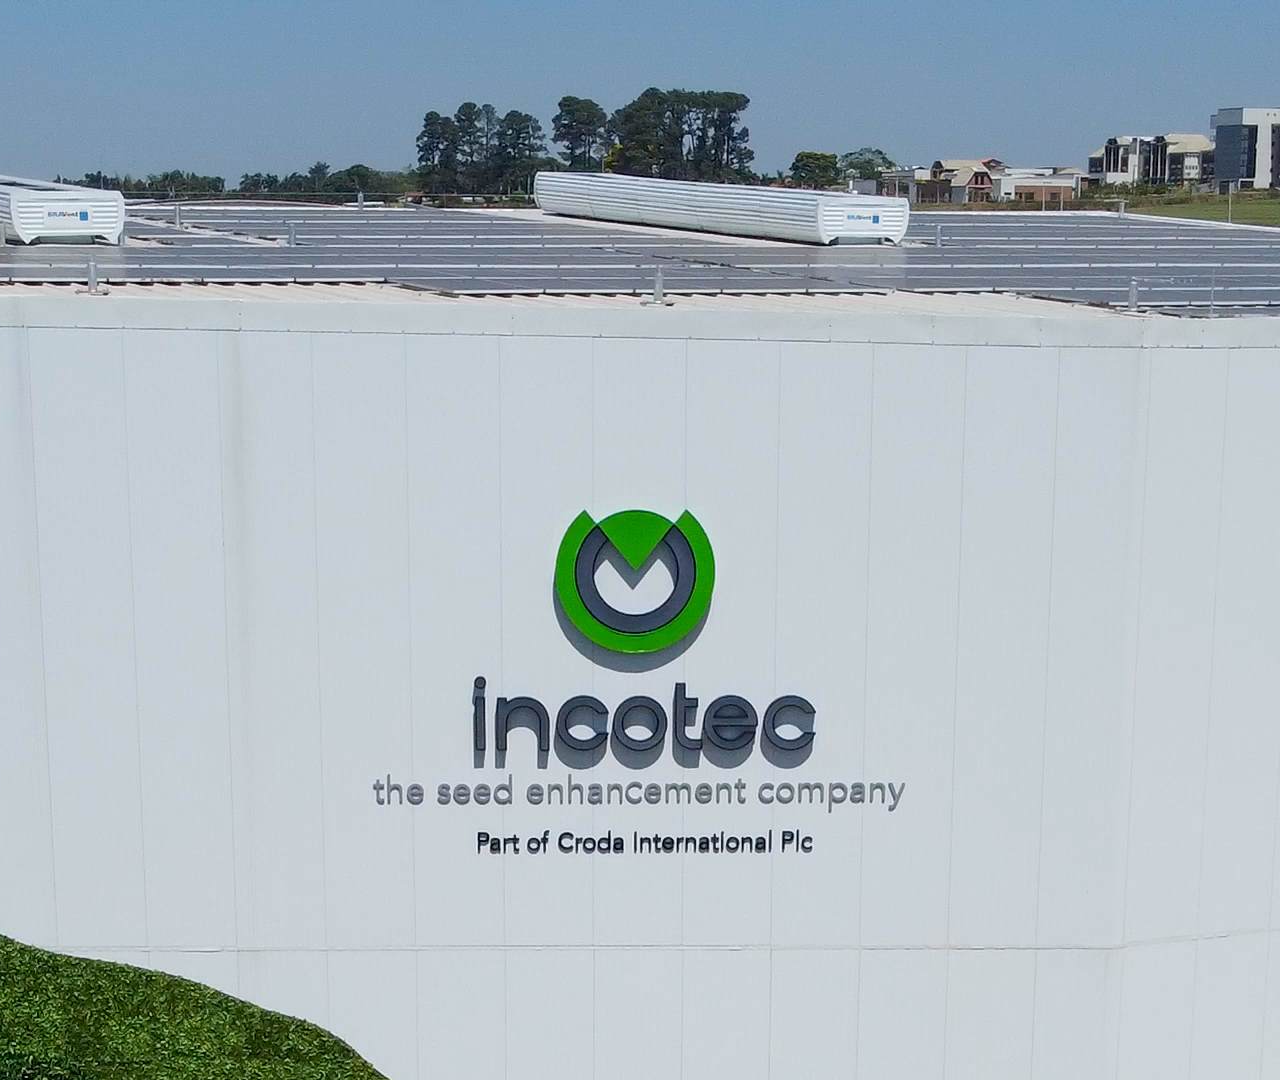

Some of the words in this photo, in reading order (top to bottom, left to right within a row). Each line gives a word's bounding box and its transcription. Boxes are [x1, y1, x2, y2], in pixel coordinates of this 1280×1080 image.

[472, 675, 816, 753] incotec
[372, 773, 424, 805] the
[437, 773, 512, 805] seed
[526, 773, 746, 805] enhancement
[757, 781, 906, 813] company
[476, 831, 520, 854] Part
[526, 829, 550, 854] of
[557, 829, 624, 854] Croda
[633, 829, 771, 854] International
[781, 828, 814, 853] Plc
